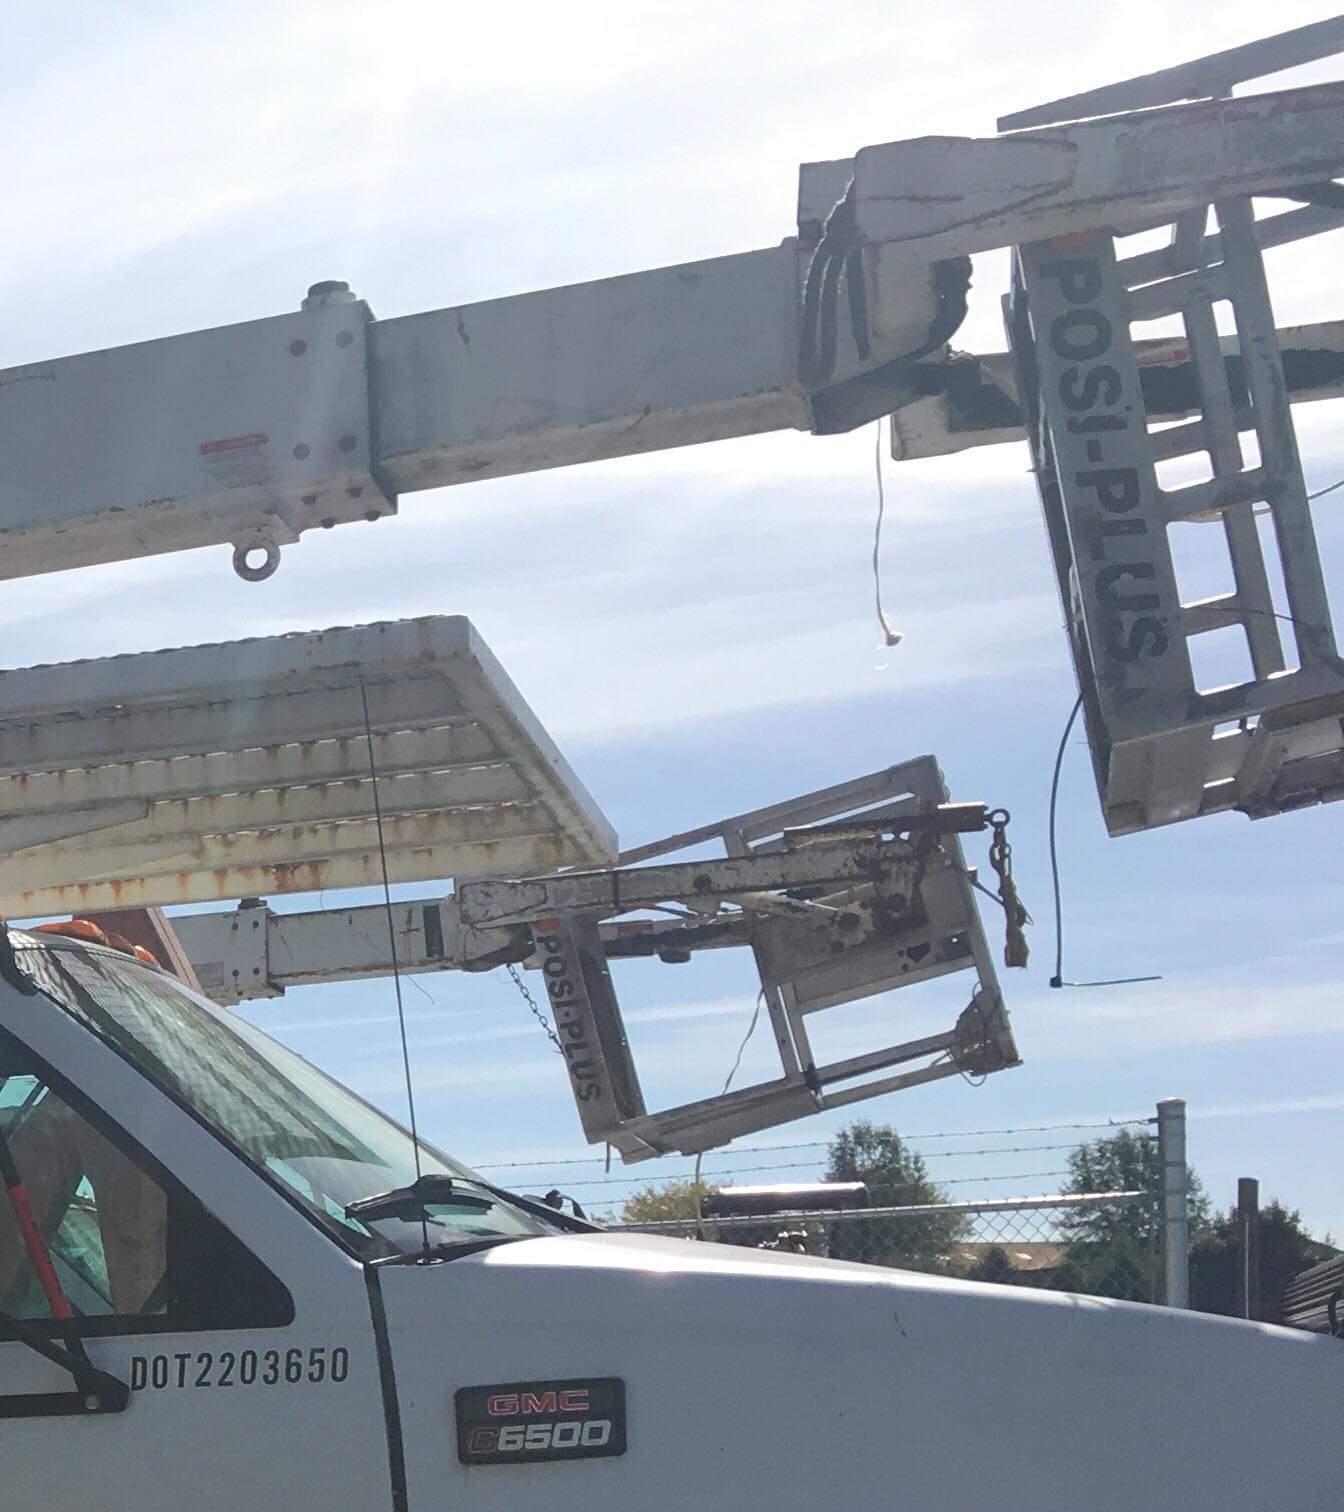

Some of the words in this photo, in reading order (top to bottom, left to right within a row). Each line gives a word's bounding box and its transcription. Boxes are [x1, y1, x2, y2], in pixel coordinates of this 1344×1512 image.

[1039, 257, 1169, 664] POSI-PLUS
[130, 1346, 350, 1391] DOT2203650
[487, 1389, 590, 1416] GMC
